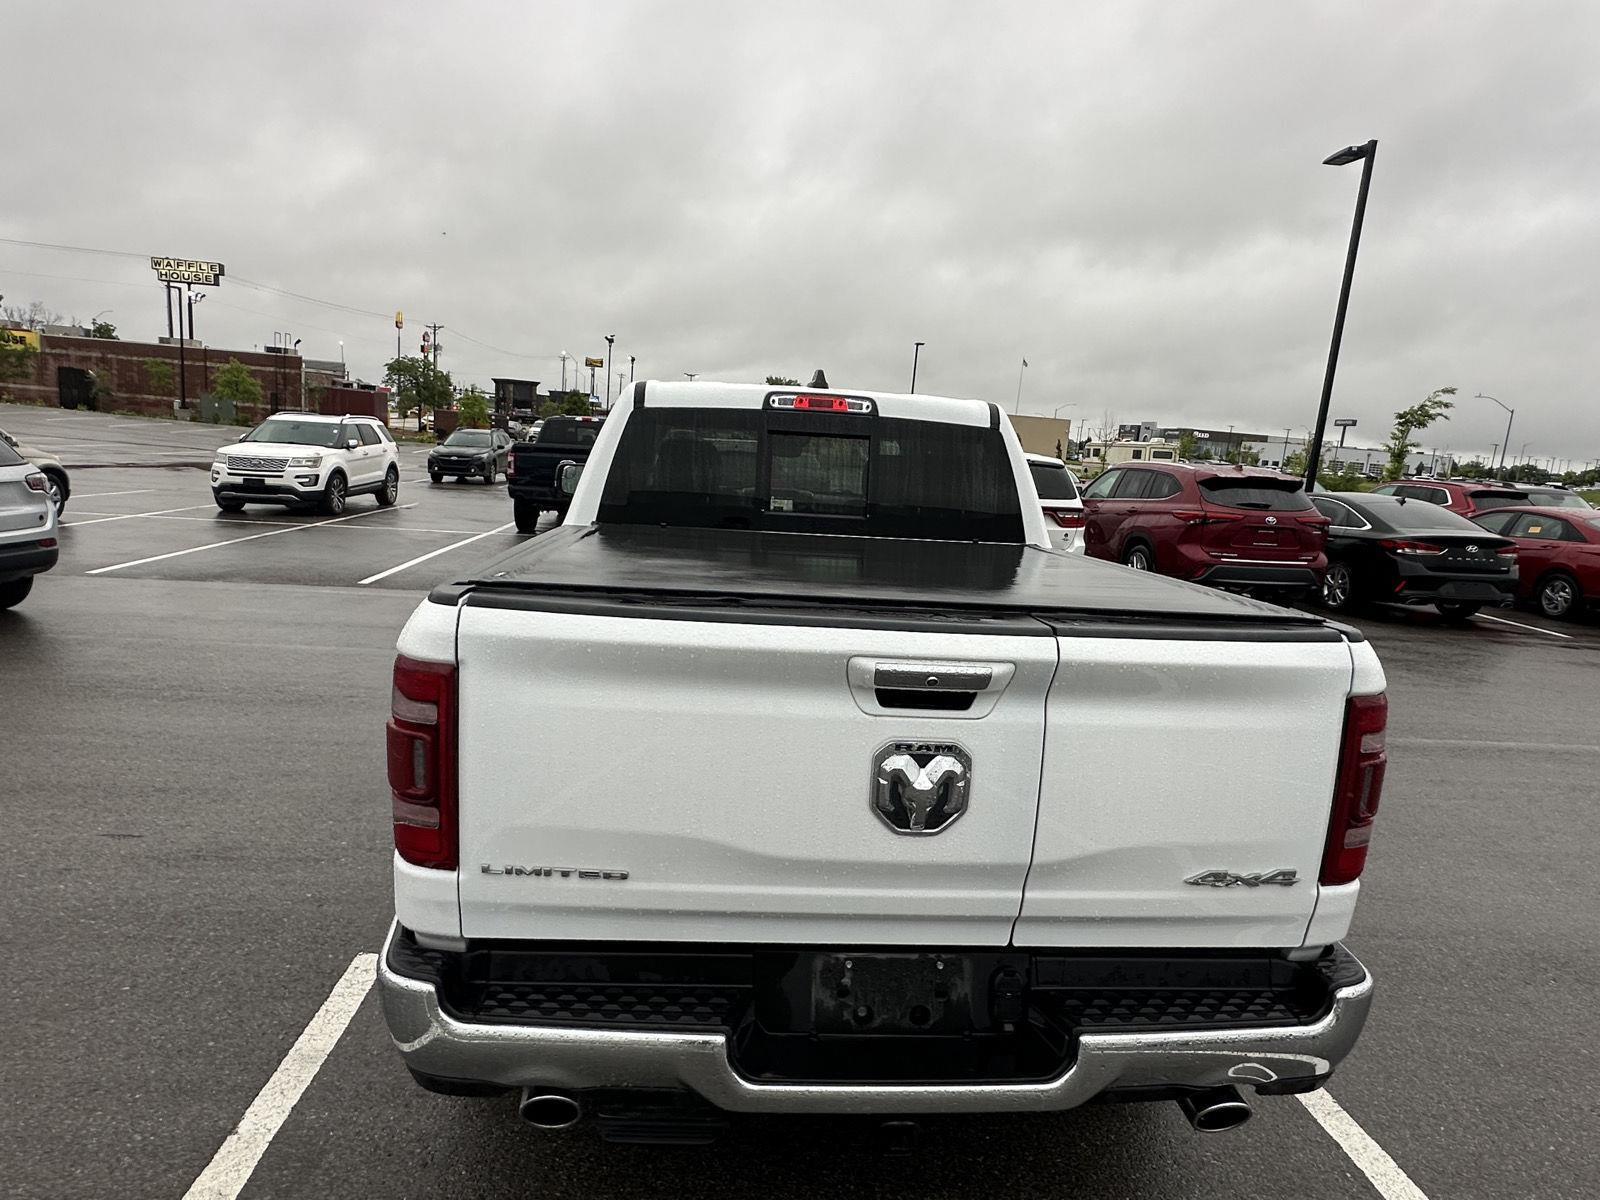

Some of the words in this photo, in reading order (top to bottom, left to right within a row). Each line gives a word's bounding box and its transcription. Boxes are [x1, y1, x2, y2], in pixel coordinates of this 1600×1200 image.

[153, 259, 219, 272] WAFFLE
[159, 270, 213, 283] HOUSE
[894, 742, 955, 752] RAM
[481, 863, 630, 880] LIMITED
